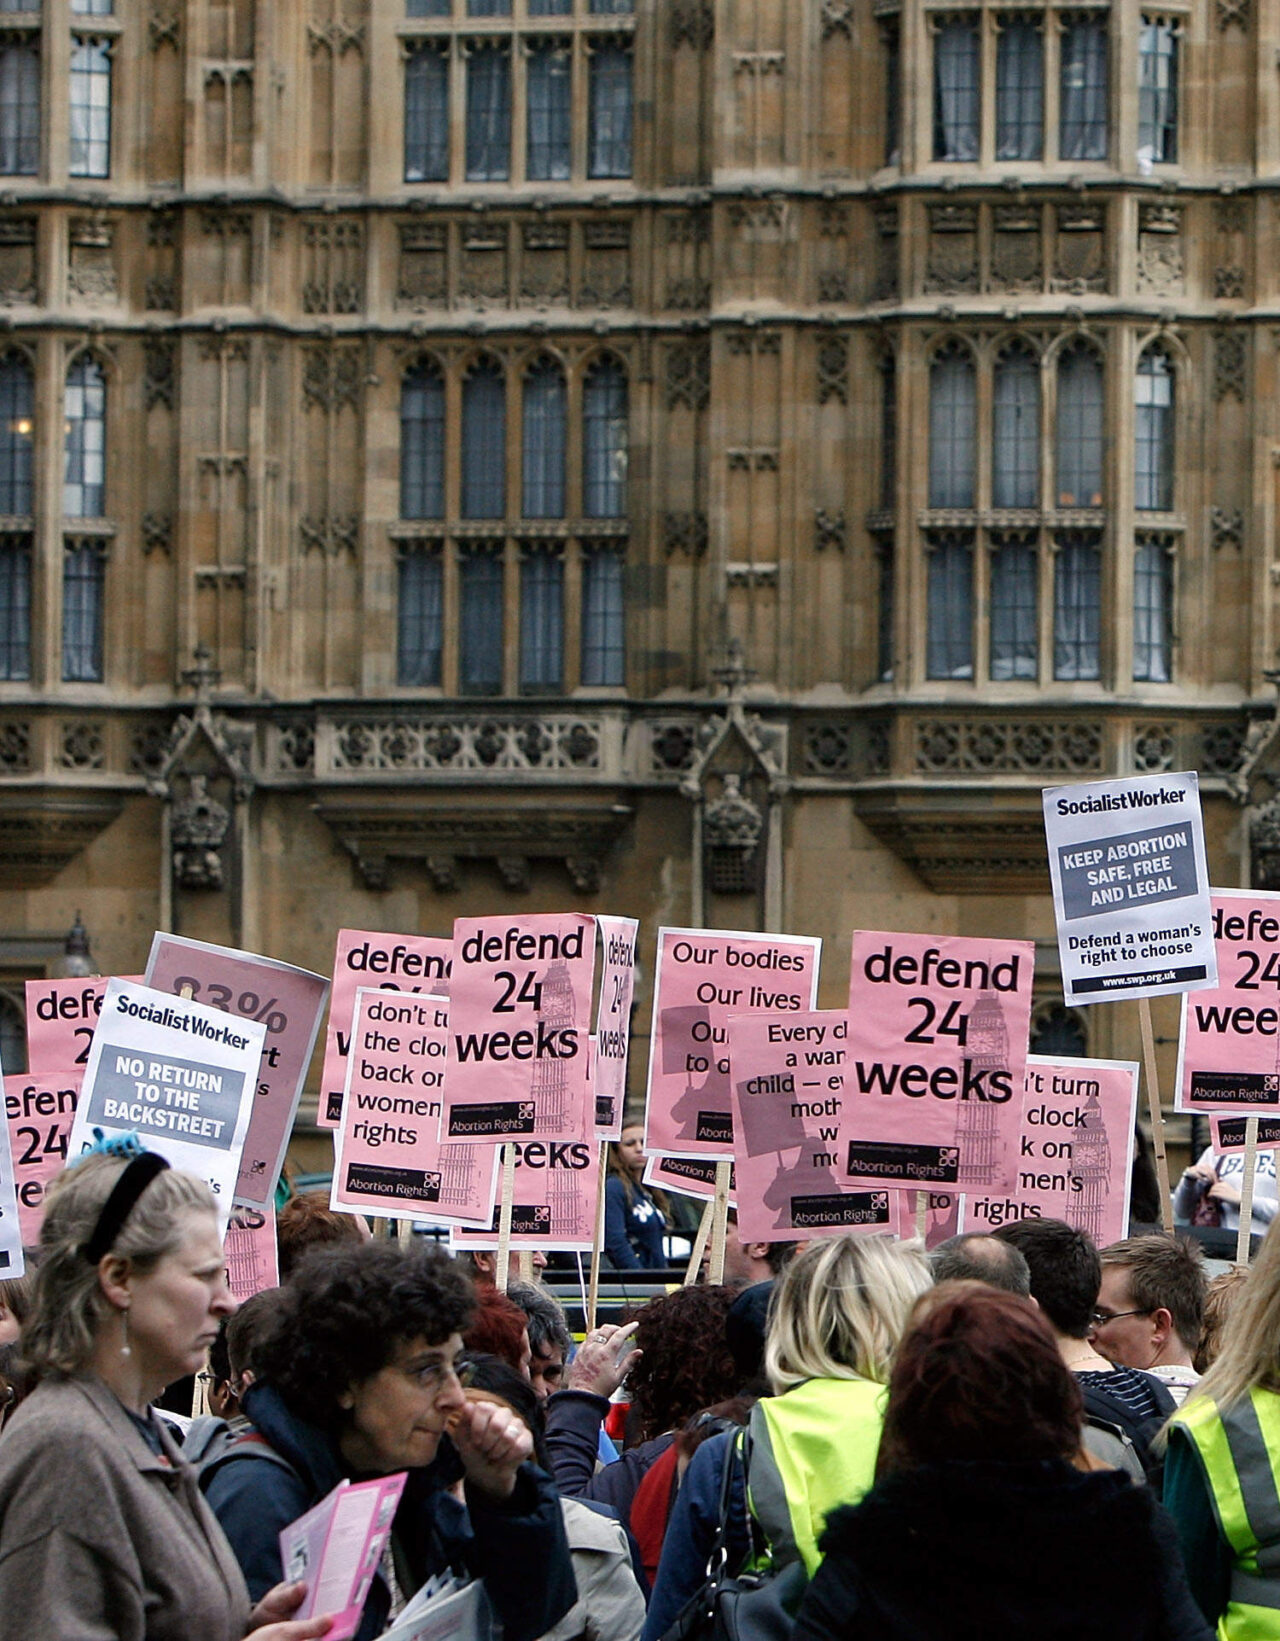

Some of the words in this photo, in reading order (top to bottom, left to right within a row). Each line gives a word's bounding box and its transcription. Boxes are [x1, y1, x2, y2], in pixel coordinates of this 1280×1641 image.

[1063, 846, 1104, 870] KEEP
[1107, 831, 1188, 863] ABORTION
[1087, 864, 1132, 887] SAFE,
[1133, 856, 1173, 878] FREE
[1091, 887, 1125, 907] AND
[1127, 876, 1178, 900] LEGAL
[461, 925, 585, 963] defend
[1068, 931, 1122, 951] Defend
[1125, 934, 1135, 945] a
[1137, 923, 1202, 943] woman's
[672, 941, 719, 966] Our
[725, 944, 805, 972] bodies
[1080, 947, 1118, 967] right
[1121, 946, 1137, 960] to
[1140, 940, 1193, 957] choose
[864, 945, 1020, 993] defend
[1102, 969, 1177, 988] www.swp.org.uk
[491, 970, 543, 1013] 24
[610, 975, 625, 1014] 24
[696, 982, 743, 1007] Our
[749, 986, 801, 1011] lives
[367, 1001, 428, 1026] don't
[904, 997, 970, 1047] 24
[364, 1030, 400, 1053] the
[408, 1036, 446, 1057] clo
[455, 1020, 579, 1063] weeks
[691, 1021, 731, 1044] Ou
[768, 1023, 826, 1047] Every
[360, 1059, 415, 1084] back
[685, 1053, 710, 1074] to
[785, 1053, 798, 1067] a
[116, 1055, 145, 1077] NO
[148, 1061, 223, 1094] RETURN
[746, 1073, 796, 1096] child
[855, 1058, 1013, 1104] weeks
[1051, 1076, 1100, 1097] turn
[6, 1086, 77, 1119] efen
[134, 1082, 160, 1102] TO
[163, 1086, 200, 1112] THE
[357, 1093, 440, 1118] women
[1193, 1085, 1236, 1098] Abortion
[1238, 1086, 1270, 1103] Rights
[103, 1099, 226, 1140] BACKSTREET
[790, 1098, 842, 1118] moth
[1027, 1105, 1088, 1129] clock
[352, 1120, 418, 1148] rights
[450, 1118, 493, 1132] Abortion
[493, 1116, 524, 1132] Rights
[17, 1124, 68, 1166] 24
[500, 1142, 590, 1170] eeks
[1041, 1140, 1073, 1161] on
[663, 1158, 706, 1179] Abortion
[849, 1159, 903, 1174] Abortion
[906, 1162, 946, 1178] Rights
[349, 1176, 396, 1194] Abortion
[396, 1182, 429, 1199] Rights
[795, 1211, 841, 1225] Abortion
[843, 1208, 878, 1222] Rights
[974, 1196, 1042, 1225] rights
